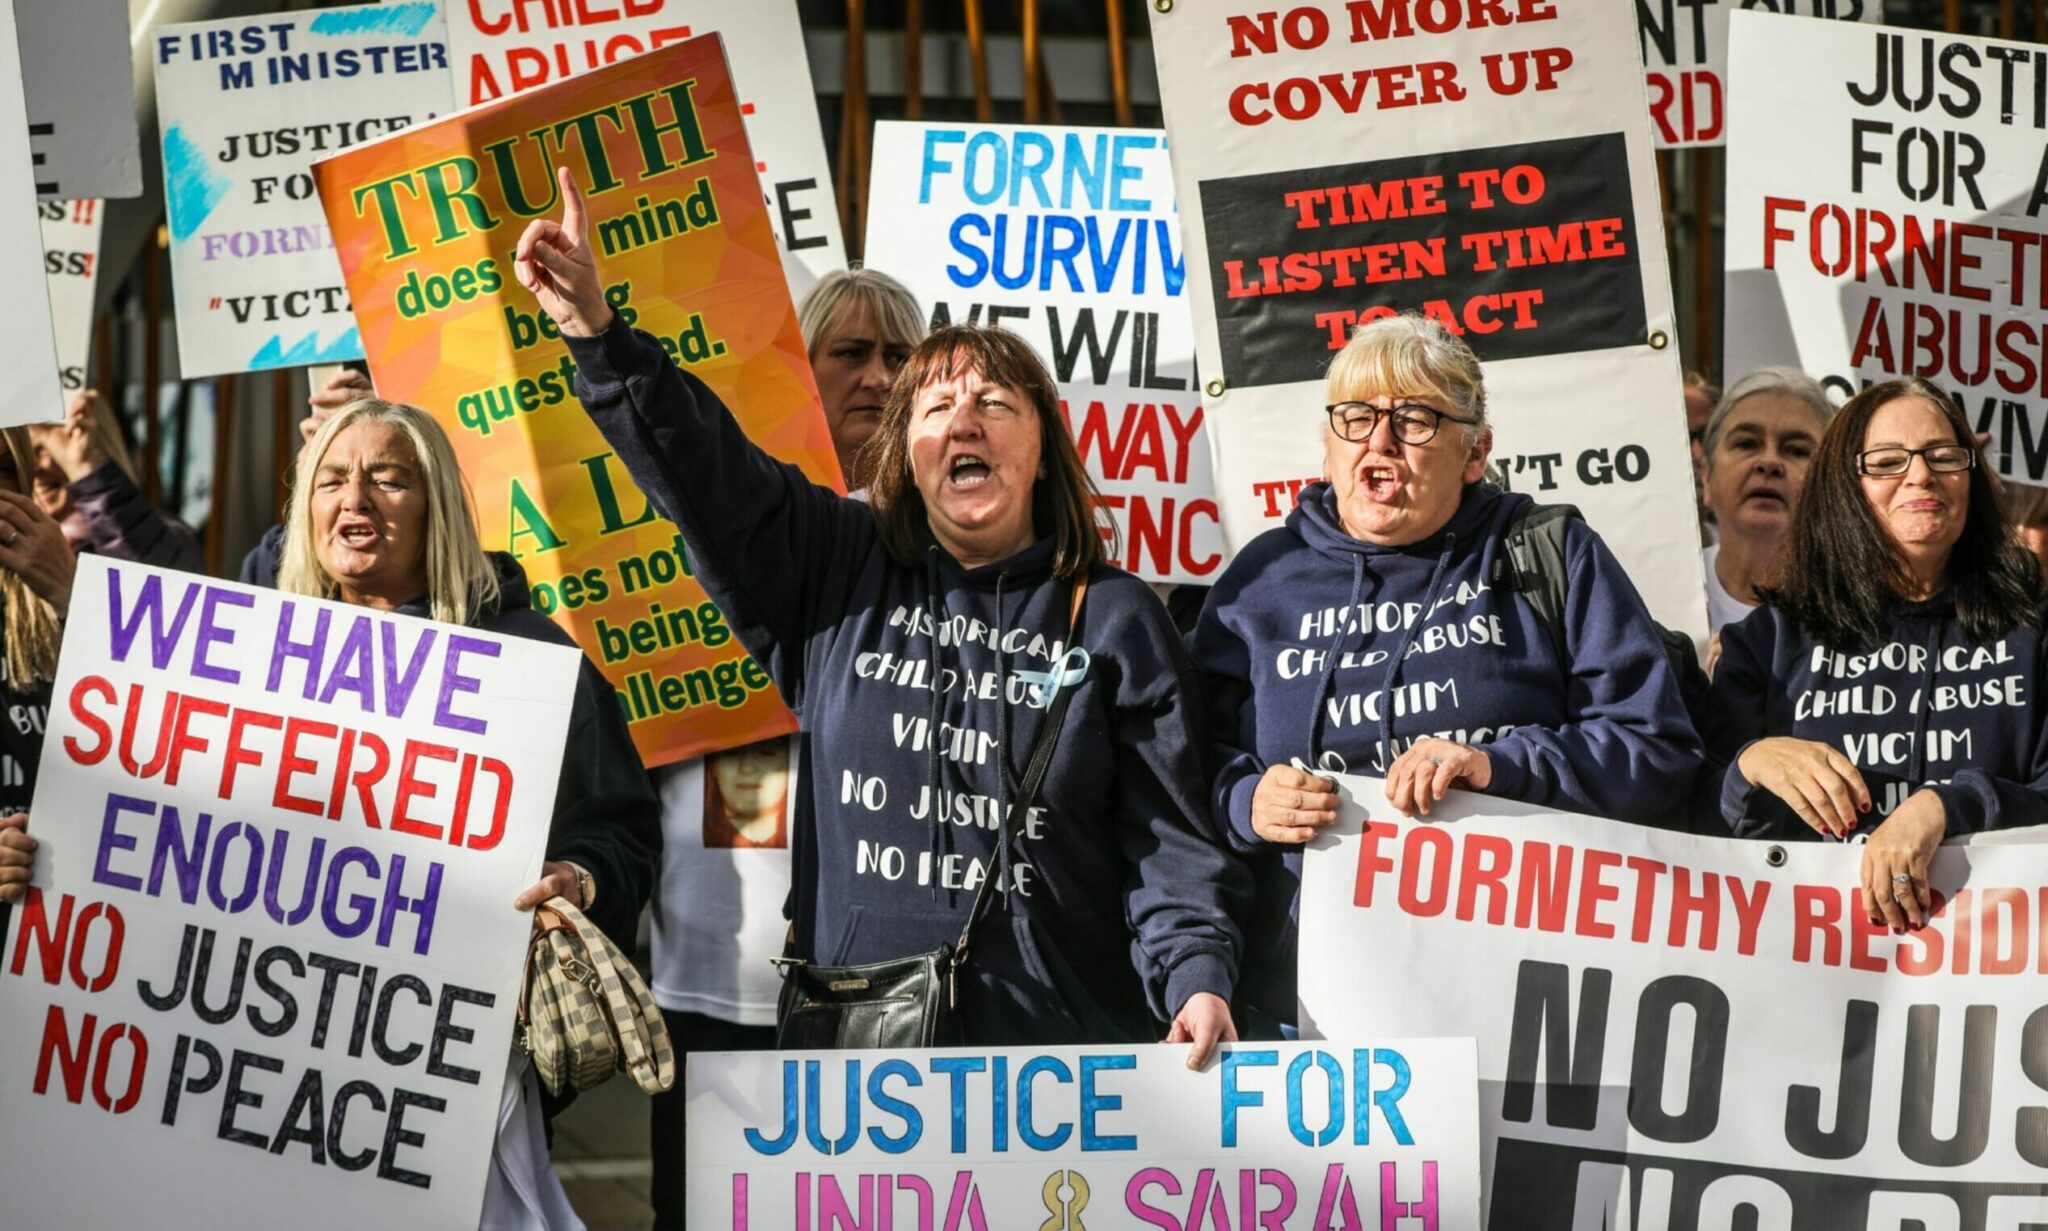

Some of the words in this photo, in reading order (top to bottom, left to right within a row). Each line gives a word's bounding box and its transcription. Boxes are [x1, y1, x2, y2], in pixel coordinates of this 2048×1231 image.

[159, 23, 295, 64] FIRST
[220, 43, 448, 90] MINISTER
[1227, 7, 1329, 58] NO
[1228, 61, 1467, 126] COVER
[1481, 47, 1574, 96] UP
[353, 79, 716, 260] TRUTH
[919, 130, 1178, 213] FORNE
[1284, 175, 1447, 229] TIME
[1458, 164, 1546, 210] TO
[1852, 118, 1988, 211] FOR
[202, 224, 337, 261] FORN
[397, 257, 503, 318] does
[598, 177, 720, 257] mind
[1223, 237, 1447, 299] LISTEN
[1461, 217, 1626, 272] TIME
[1046, 305, 1202, 392] WIL
[1423, 289, 1544, 336] ACT
[1577, 444, 1650, 486] GO
[509, 477, 567, 558] A
[618, 534, 695, 593] not
[107, 568, 255, 685] WE
[265, 601, 501, 735] HAVE
[594, 600, 730, 664] being
[1404, 615, 1506, 660] ABUSE
[1811, 640, 2014, 678] HISTORICAL
[1327, 678, 1459, 728] VICTIM
[1795, 685, 1896, 721] CHILD
[63, 675, 514, 851] SUFFERED
[842, 770, 887, 811] NO
[92, 793, 444, 956] ENOUGH
[857, 839, 905, 880] NO
[1353, 821, 1771, 956] FORNETHY
[1793, 884, 2048, 977] RESID
[10, 886, 125, 993] NO
[137, 924, 496, 1084] JUSTICE
[1502, 959, 1731, 1144] NO
[33, 1004, 147, 1113] NO
[161, 1034, 447, 1190] PEACE
[743, 1053, 1137, 1156] JUSTICE
[1220, 1048, 1416, 1149] FOR
